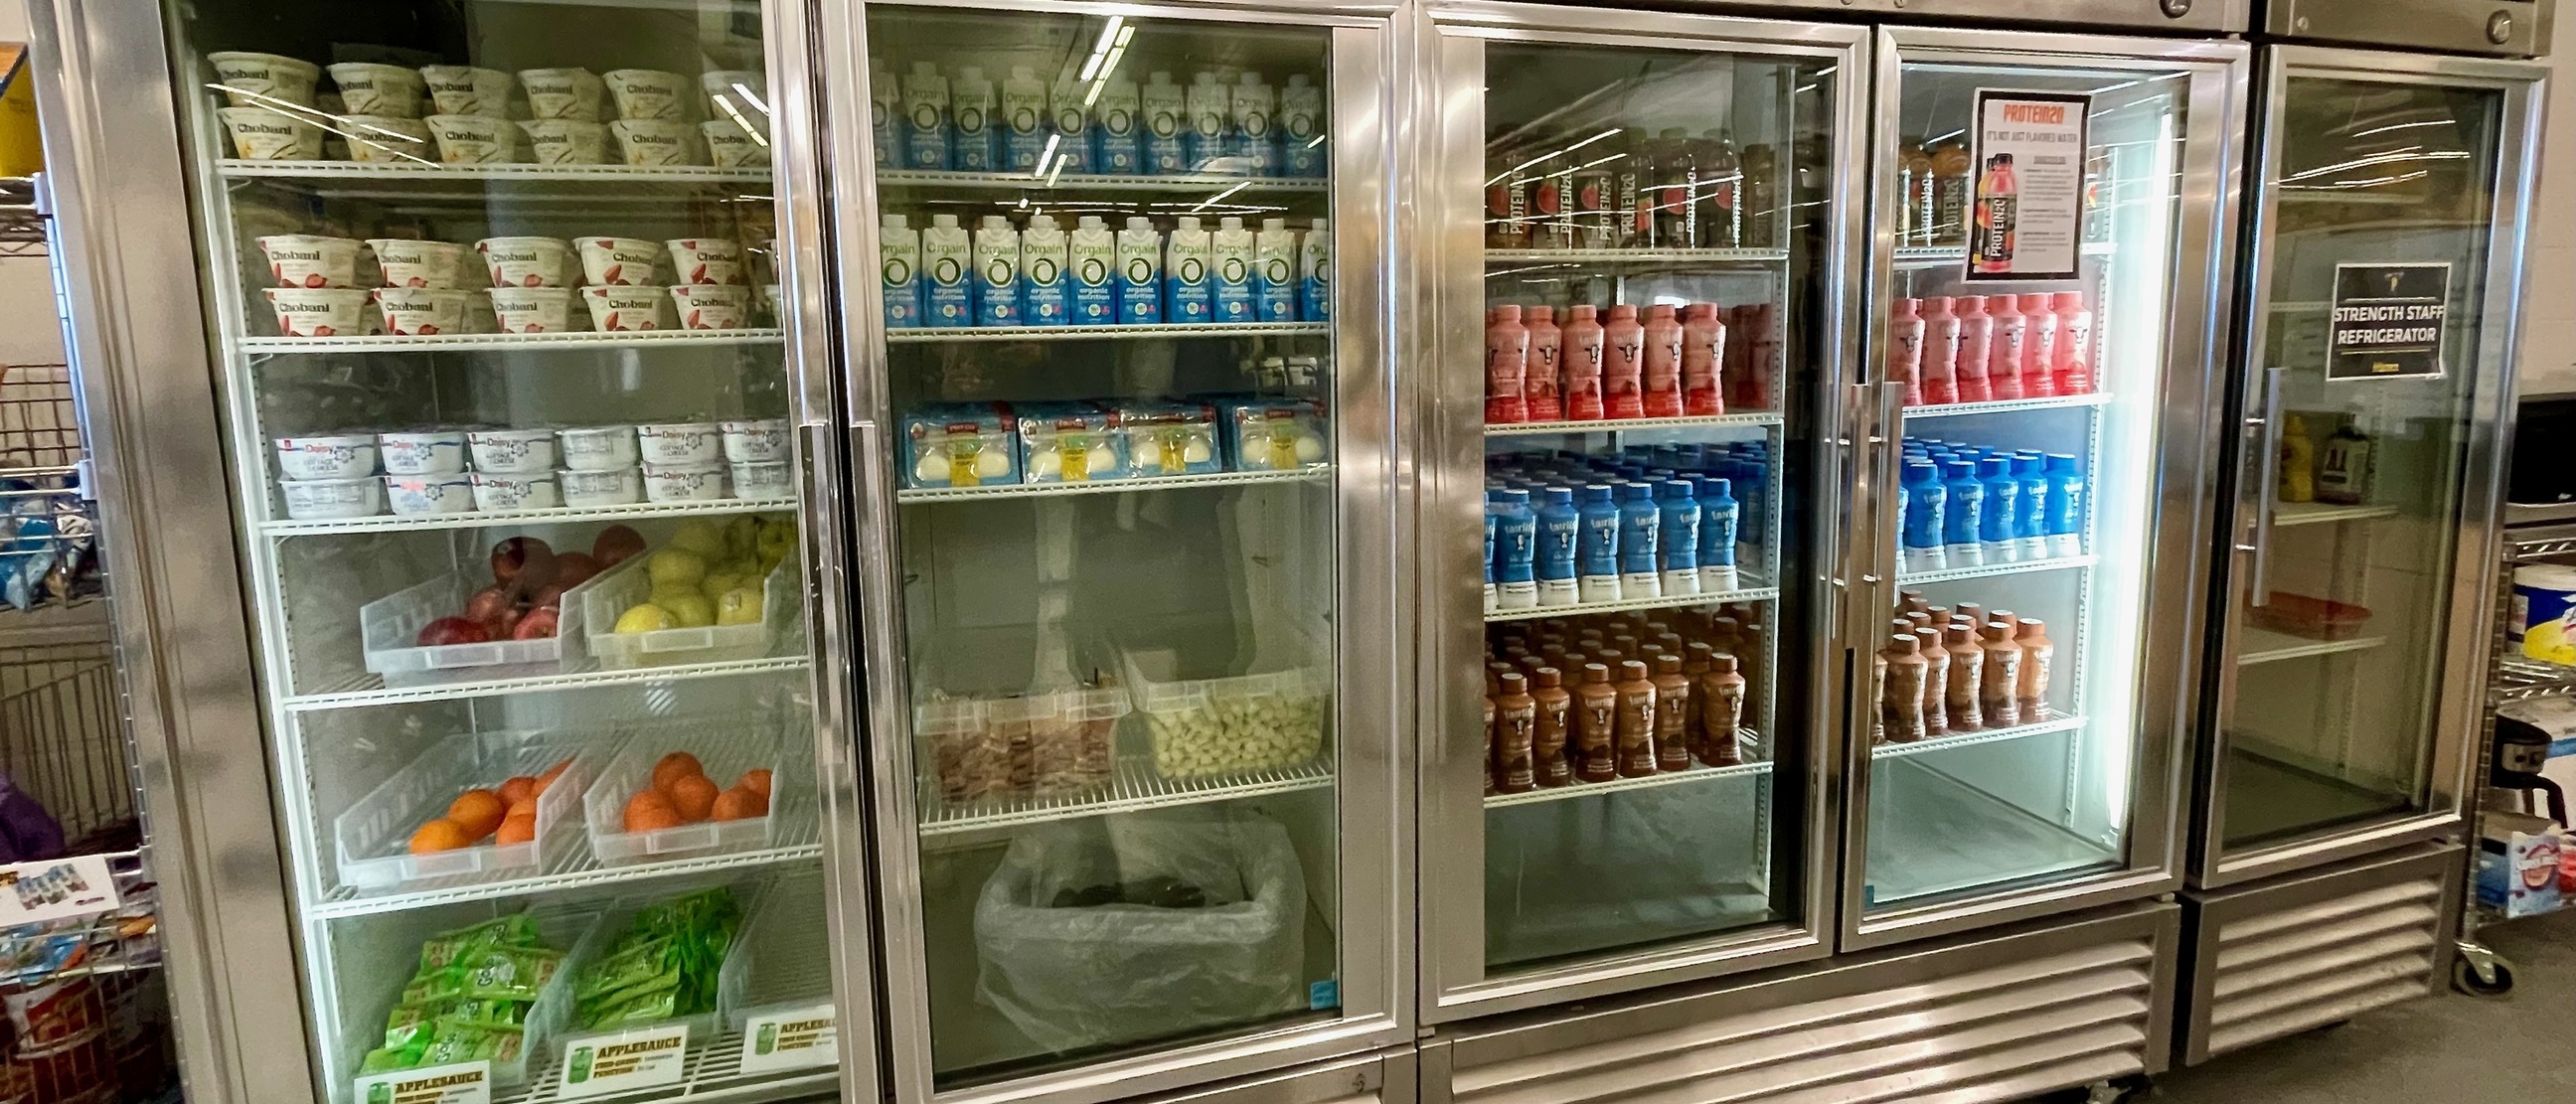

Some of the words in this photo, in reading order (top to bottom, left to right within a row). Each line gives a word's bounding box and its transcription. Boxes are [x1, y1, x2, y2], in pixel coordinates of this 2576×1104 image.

[238, 122, 292, 136] Chobani
[444, 130, 496, 143] Chobani
[631, 133, 678, 145] Chobani
[1999, 131, 2010, 141] NOT
[926, 242, 966, 254] Orgain
[978, 243, 1017, 255] Orgain
[1024, 243, 1062, 254] Orgain
[1074, 243, 1111, 254] Orgain
[1120, 243, 1157, 254] Orgain
[271, 250, 321, 261] Chobani
[492, 251, 537, 263] Chobani
[279, 301, 330, 313] Chobani
[386, 301, 433, 312] Chobani
[608, 299, 653, 310] Chobani
[2334, 306, 2404, 322] STRENGTH
[2406, 305, 2444, 320] STAFF
[2337, 327, 2437, 345] REFRIGERATOR
[597, 1036, 682, 1059] APPLESAUCE
[395, 1070, 483, 1094] APPLESAUCE
